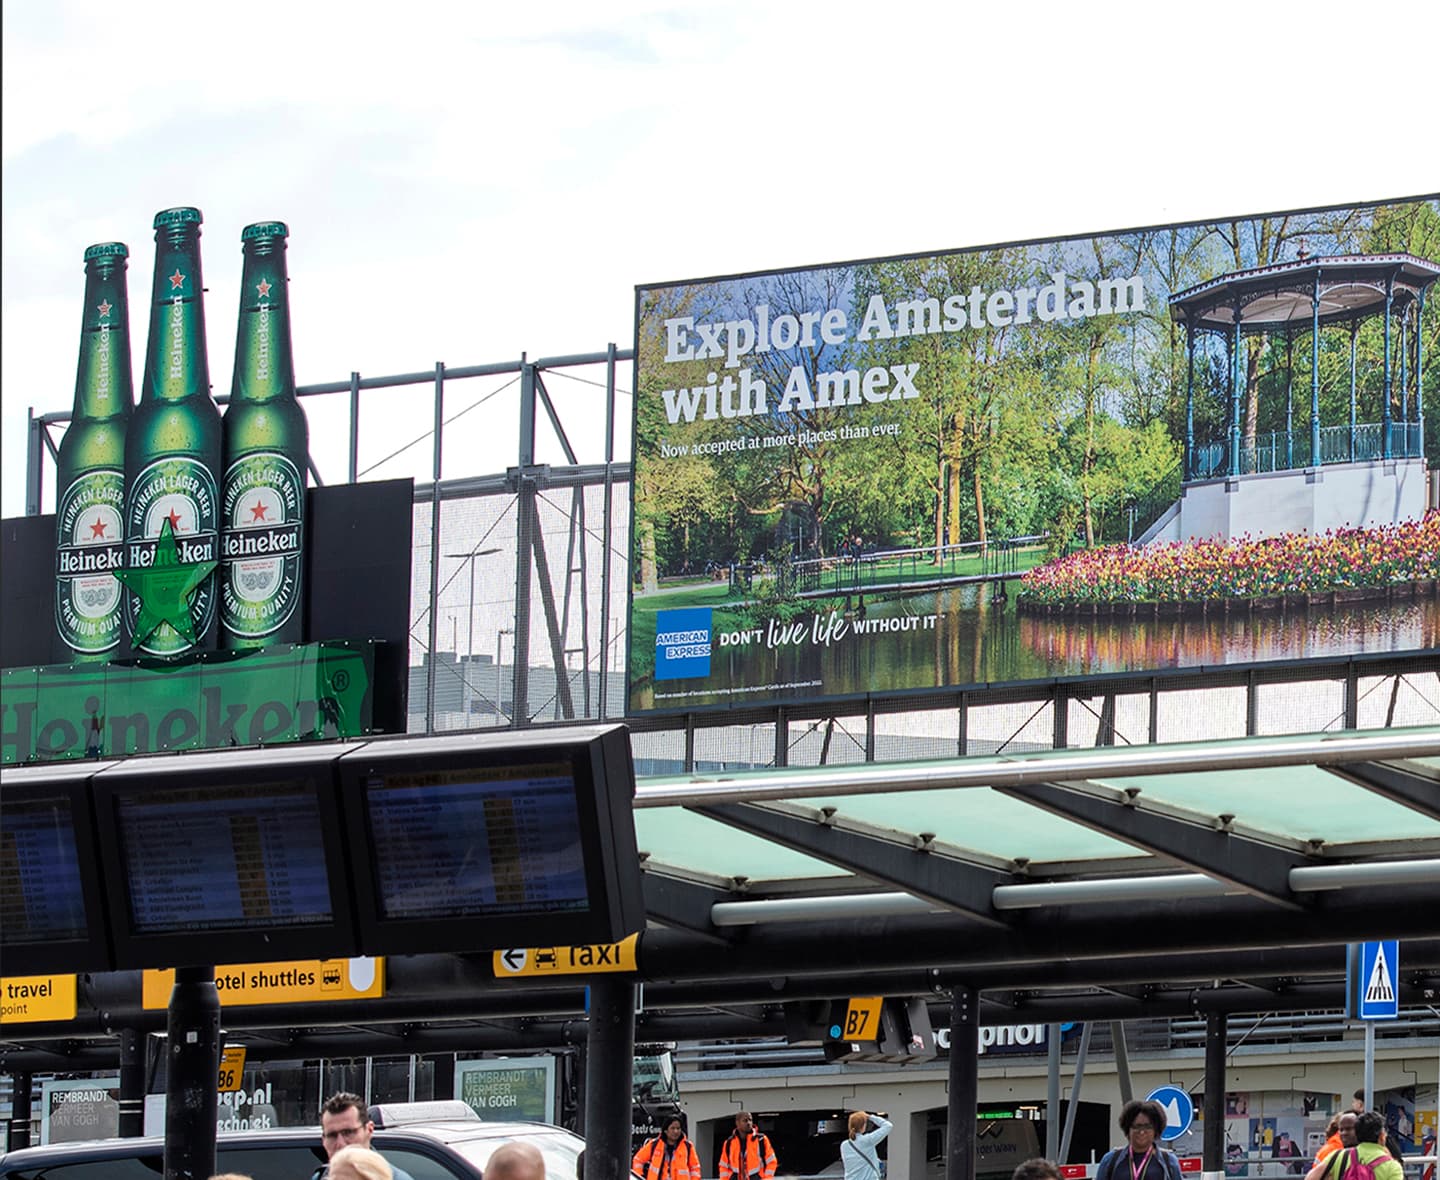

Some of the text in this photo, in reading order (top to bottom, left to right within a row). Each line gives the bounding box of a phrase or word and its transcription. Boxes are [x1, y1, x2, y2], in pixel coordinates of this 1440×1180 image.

[663, 272, 1146, 367] Explore Amsterdam
[170, 293, 184, 380] Heineken
[256, 302, 270, 381] Heineken
[97, 322, 110, 401] Heineken
[661, 363, 920, 424] with Amex
[660, 443, 688, 458] Now
[691, 437, 746, 455] accepted
[748, 437, 761, 449] at
[763, 433, 796, 447] more
[798, 428, 837, 446] places
[839, 425, 869, 439] than
[63, 489, 94, 533] HEINEKEN
[133, 474, 211, 524] HEINEKEN LAGER BEER
[222, 576, 293, 620] PREMIUM QUALITY
[61, 598, 97, 637] PREMIUM
[720, 628, 763, 646] DON'T
[766, 618, 808, 649] live
[811, 610, 850, 647] life
[853, 616, 920, 635] WITHOUT
[656, 630, 709, 646] AMERICAN
[665, 645, 712, 660] EXPRESS
[7, 979, 52, 998] travel
[215, 969, 315, 990] otel shuttles
[846, 1010, 870, 1035] B7
[465, 1070, 526, 1084] REMBRANDT
[465, 1084, 511, 1096] VERMEER
[52, 1090, 109, 1103] REMBRANDT
[488, 1095, 517, 1108] GOGH
[72, 1114, 100, 1126] GOGH
[217, 1113, 271, 1131] echniek
